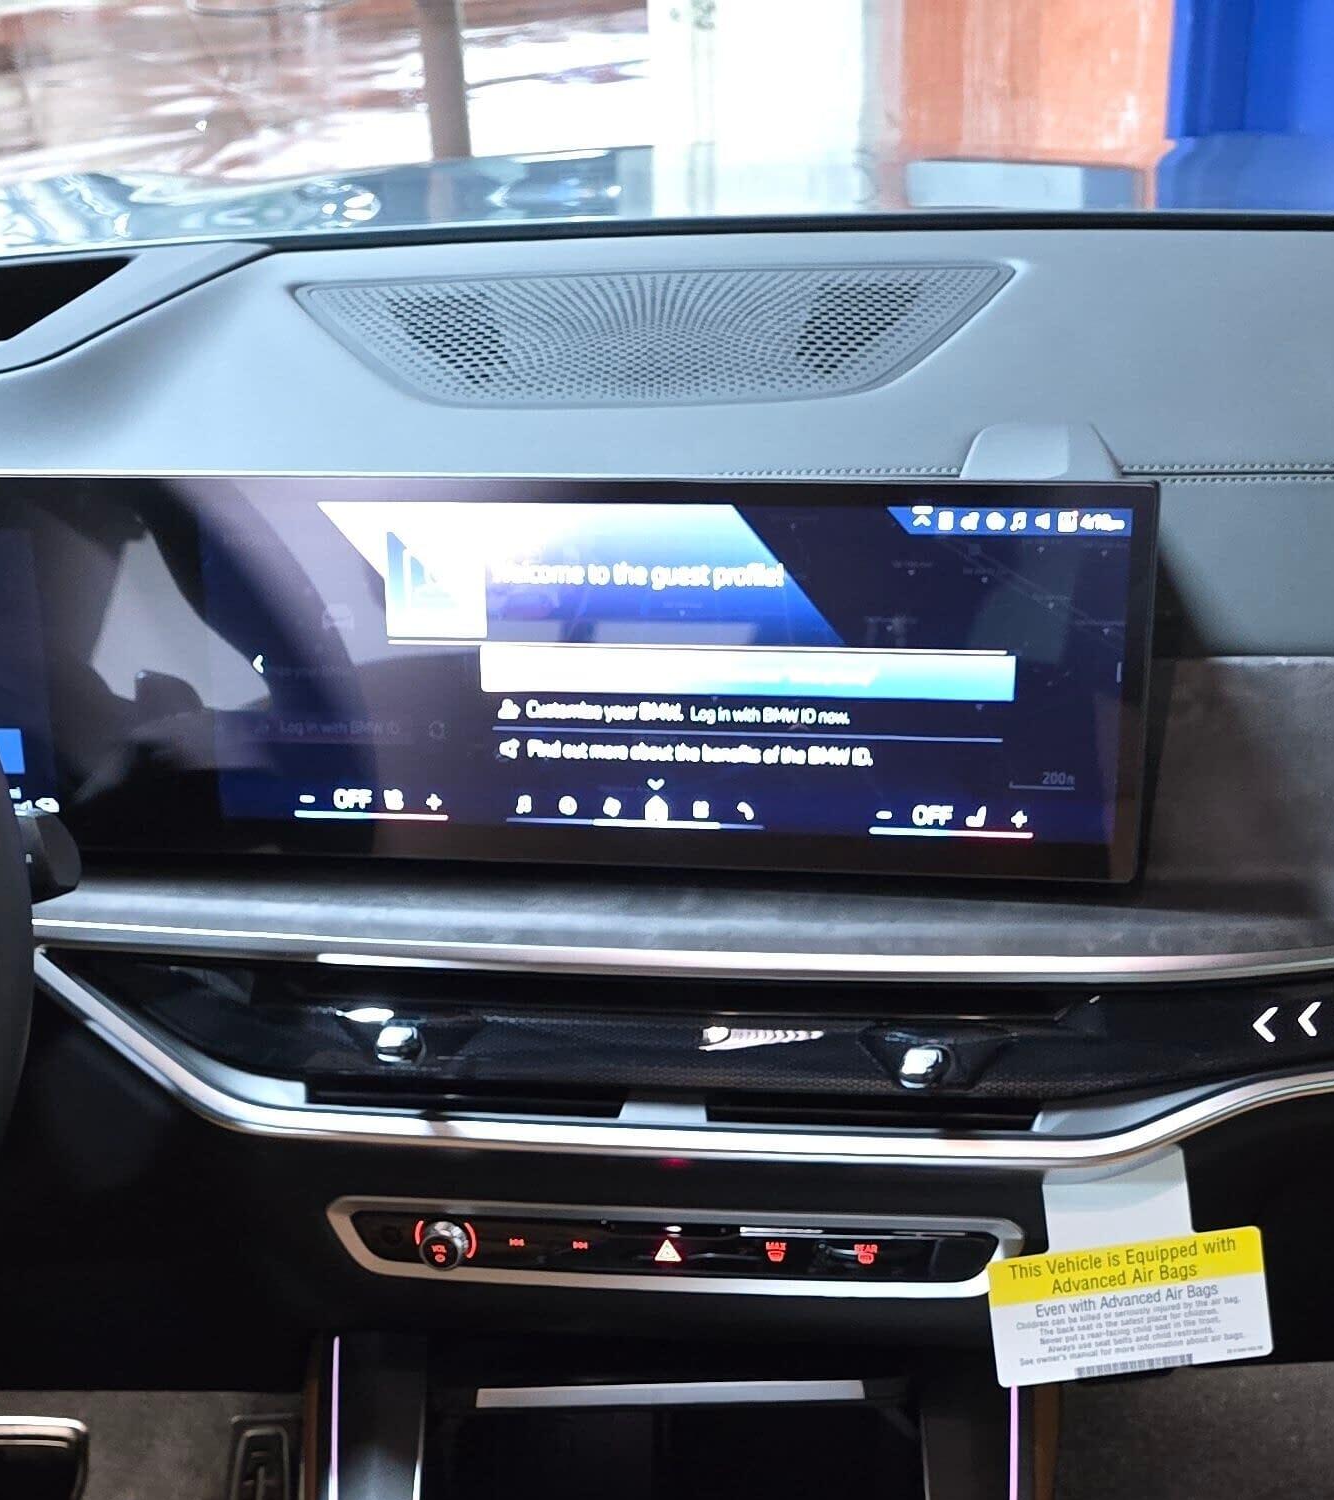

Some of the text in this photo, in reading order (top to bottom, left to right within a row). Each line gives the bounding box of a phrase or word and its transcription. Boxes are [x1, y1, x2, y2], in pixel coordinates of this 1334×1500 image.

[333, 788, 372, 809] OFF
[912, 804, 954, 826] OFF
[1009, 1237, 1236, 1280] This Vehicle is Equipped with
[1052, 1263, 1197, 1294] Advanced Air Bags
[1035, 1284, 1219, 1318] Even with Advanced Air Bags
